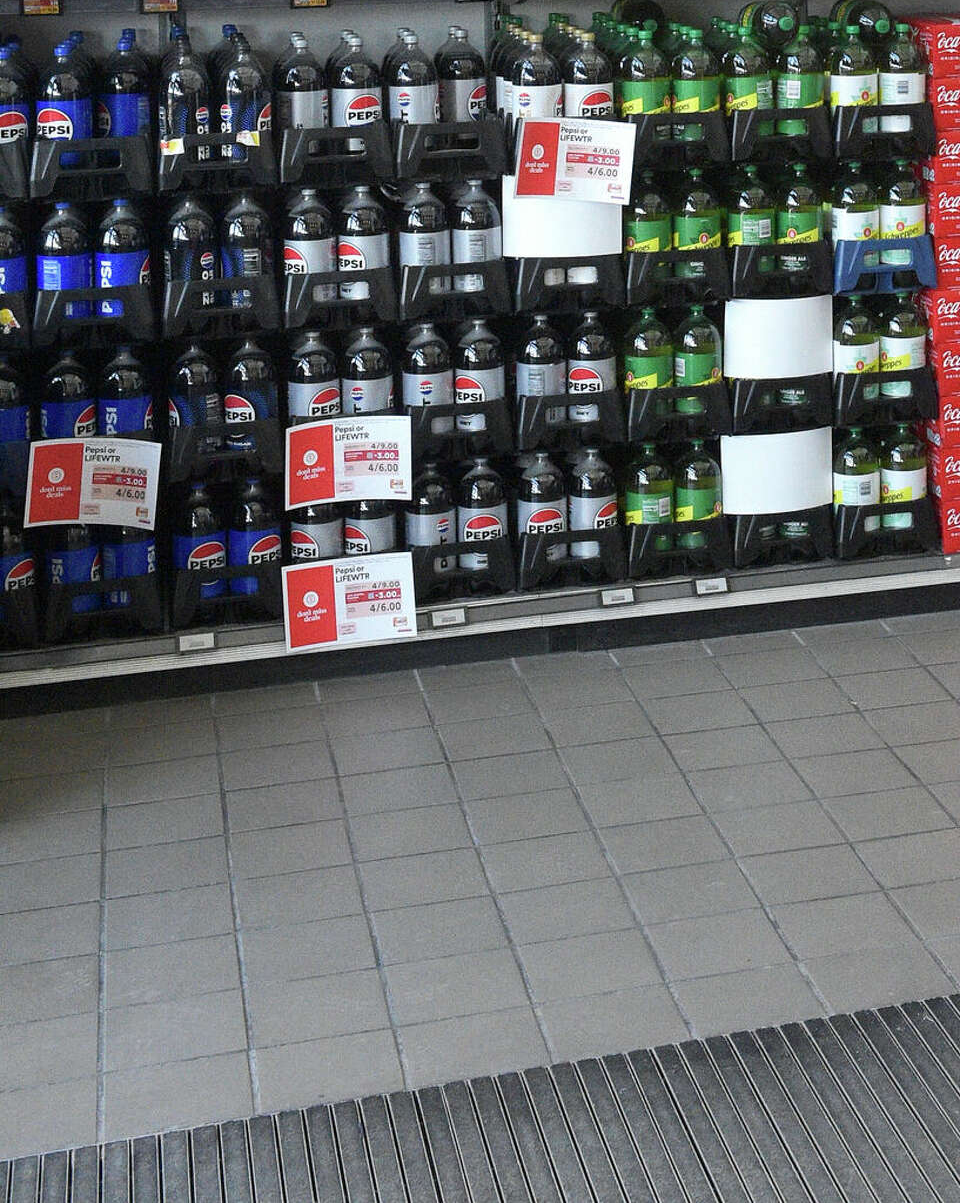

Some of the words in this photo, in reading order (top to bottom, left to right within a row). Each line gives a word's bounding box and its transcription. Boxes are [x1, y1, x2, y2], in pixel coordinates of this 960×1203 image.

[582, 106, 611, 116] PEPS
[36, 125, 70, 135] PEPSI
[560, 126, 579, 135] Pepsi
[560, 135, 592, 143] LIFEWTR
[592, 147, 620, 155] 4/9.00
[587, 166, 618, 177] 4/6.00
[340, 260, 363, 269] EPSI
[334, 425, 355, 434] Pepsi
[334, 433, 370, 442] LIFEWTR
[84, 445, 106, 455] Pepsi
[370, 442, 398, 450] 4/9.00
[84, 455, 120, 463] LIFEWTR
[120, 467, 148, 477] 4/9.00
[368, 463, 398, 473] 4/6.00
[116, 489, 146, 499] 4/6.00
[335, 566, 356, 575] Pepsi
[336, 573, 370, 583] LIFEWTR
[371, 580, 400, 589] 4/9.00
[370, 601, 401, 613] 4/6.00
